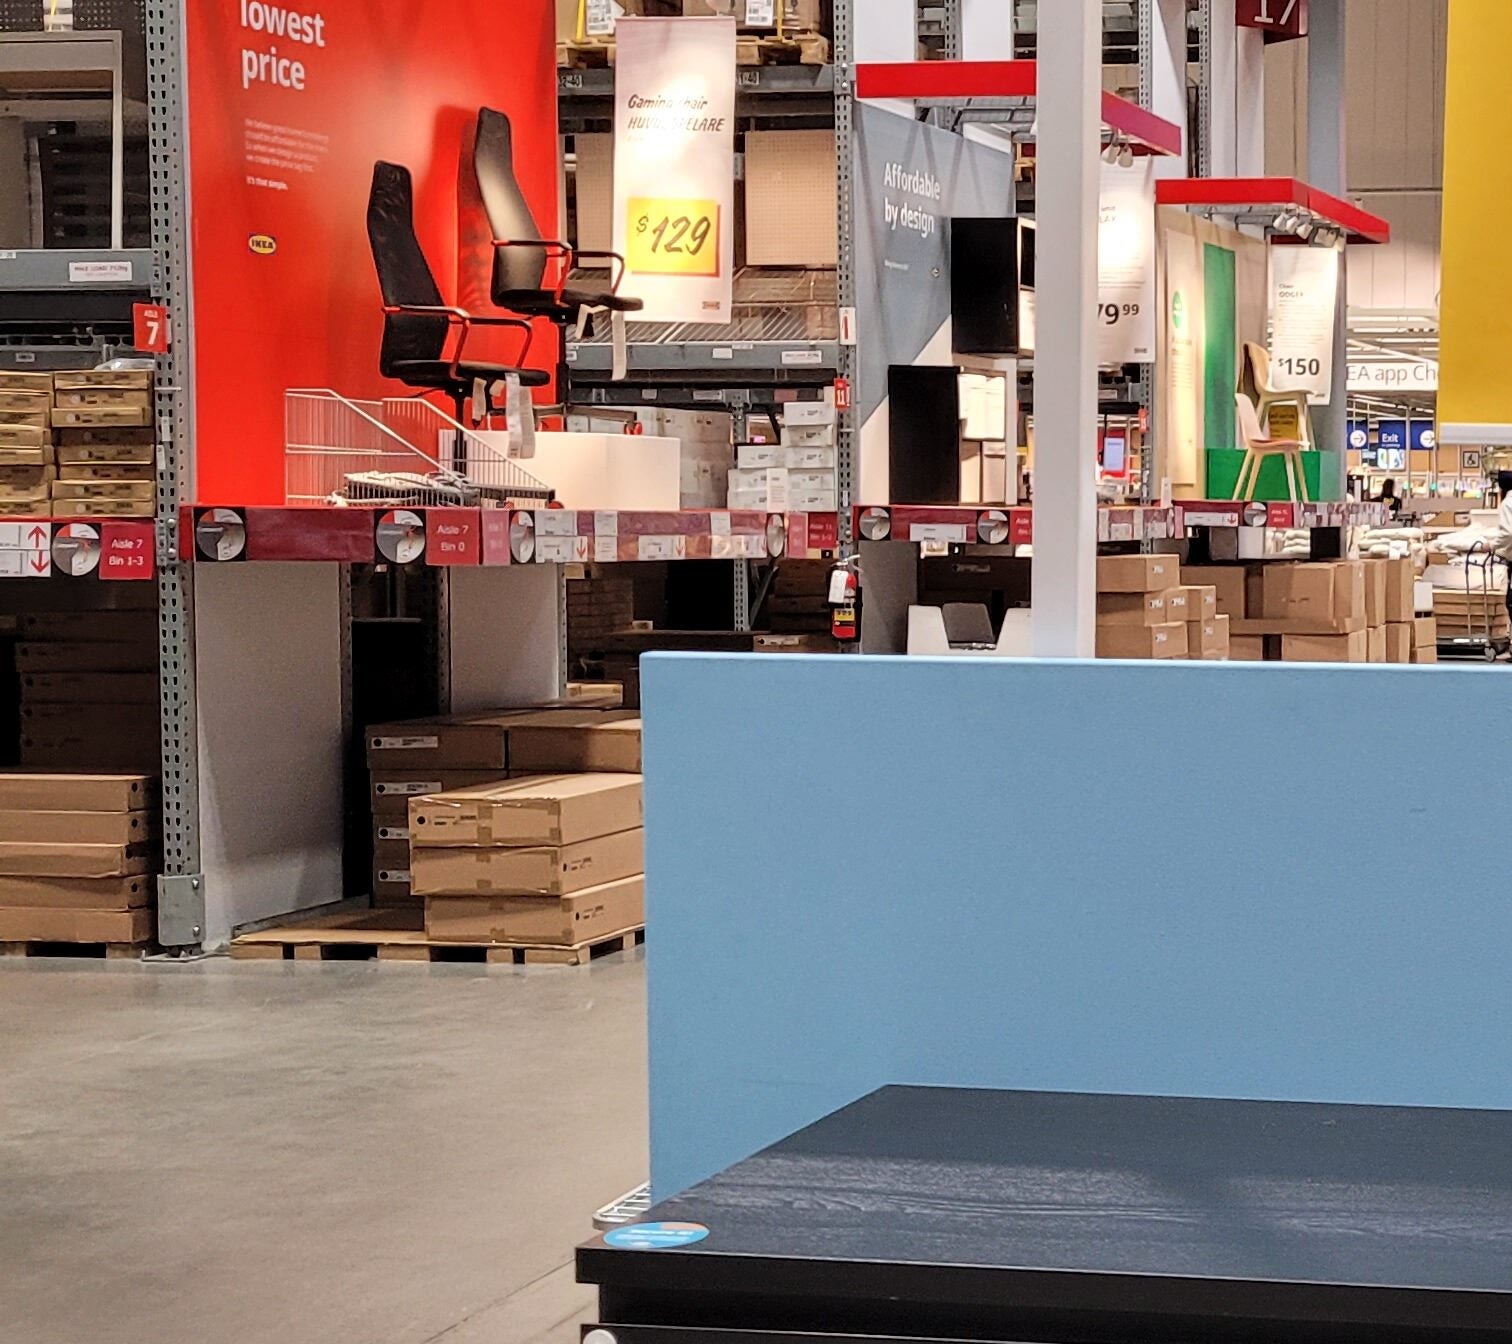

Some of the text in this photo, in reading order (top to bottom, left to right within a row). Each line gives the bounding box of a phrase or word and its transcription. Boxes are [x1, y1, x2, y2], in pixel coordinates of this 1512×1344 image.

[242, 46, 305, 90] price
[628, 94, 707, 110] Gamin hair
[884, 162, 940, 200] Affordable
[884, 197, 934, 238] by design
[637, 213, 711, 256] $129
[1123, 304, 1139, 315] 99
[147, 321, 159, 345] 7
[1278, 357, 1320, 376] $150
[1346, 363, 1435, 385] EA app Ch
[1382, 434, 1399, 443] Exit
[462, 525, 468, 533] 7
[112, 540, 143, 548] Aisle 7
[109, 557, 144, 566] Bin 1-3
